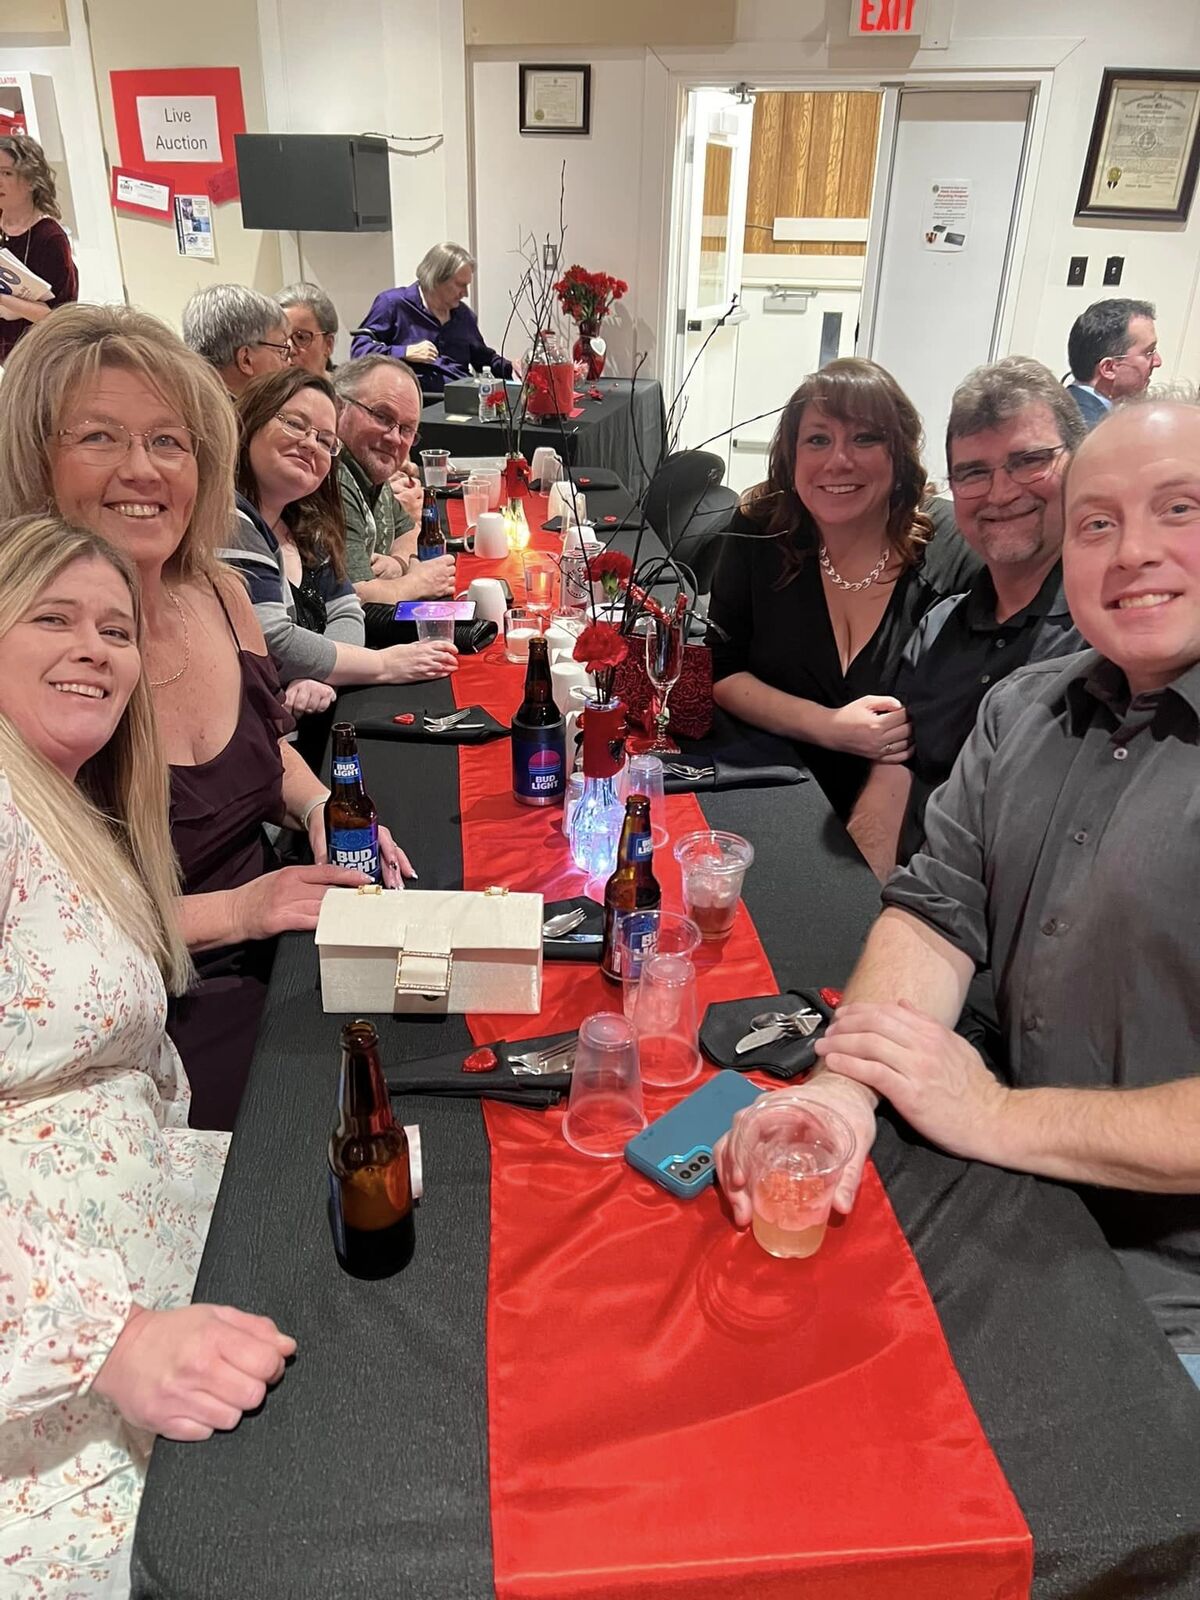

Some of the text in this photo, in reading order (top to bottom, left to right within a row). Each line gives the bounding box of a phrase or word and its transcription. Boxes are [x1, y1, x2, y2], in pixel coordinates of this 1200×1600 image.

[860, 0, 915, 31] EXIT
[164, 107, 192, 123] Live
[156, 135, 208, 150] Auction
[333, 768, 359, 777] LIGHT
[336, 763, 356, 771] BUD
[531, 780, 559, 790] LIGHT
[535, 775, 556, 783] BUD
[336, 849, 372, 863] BUD
